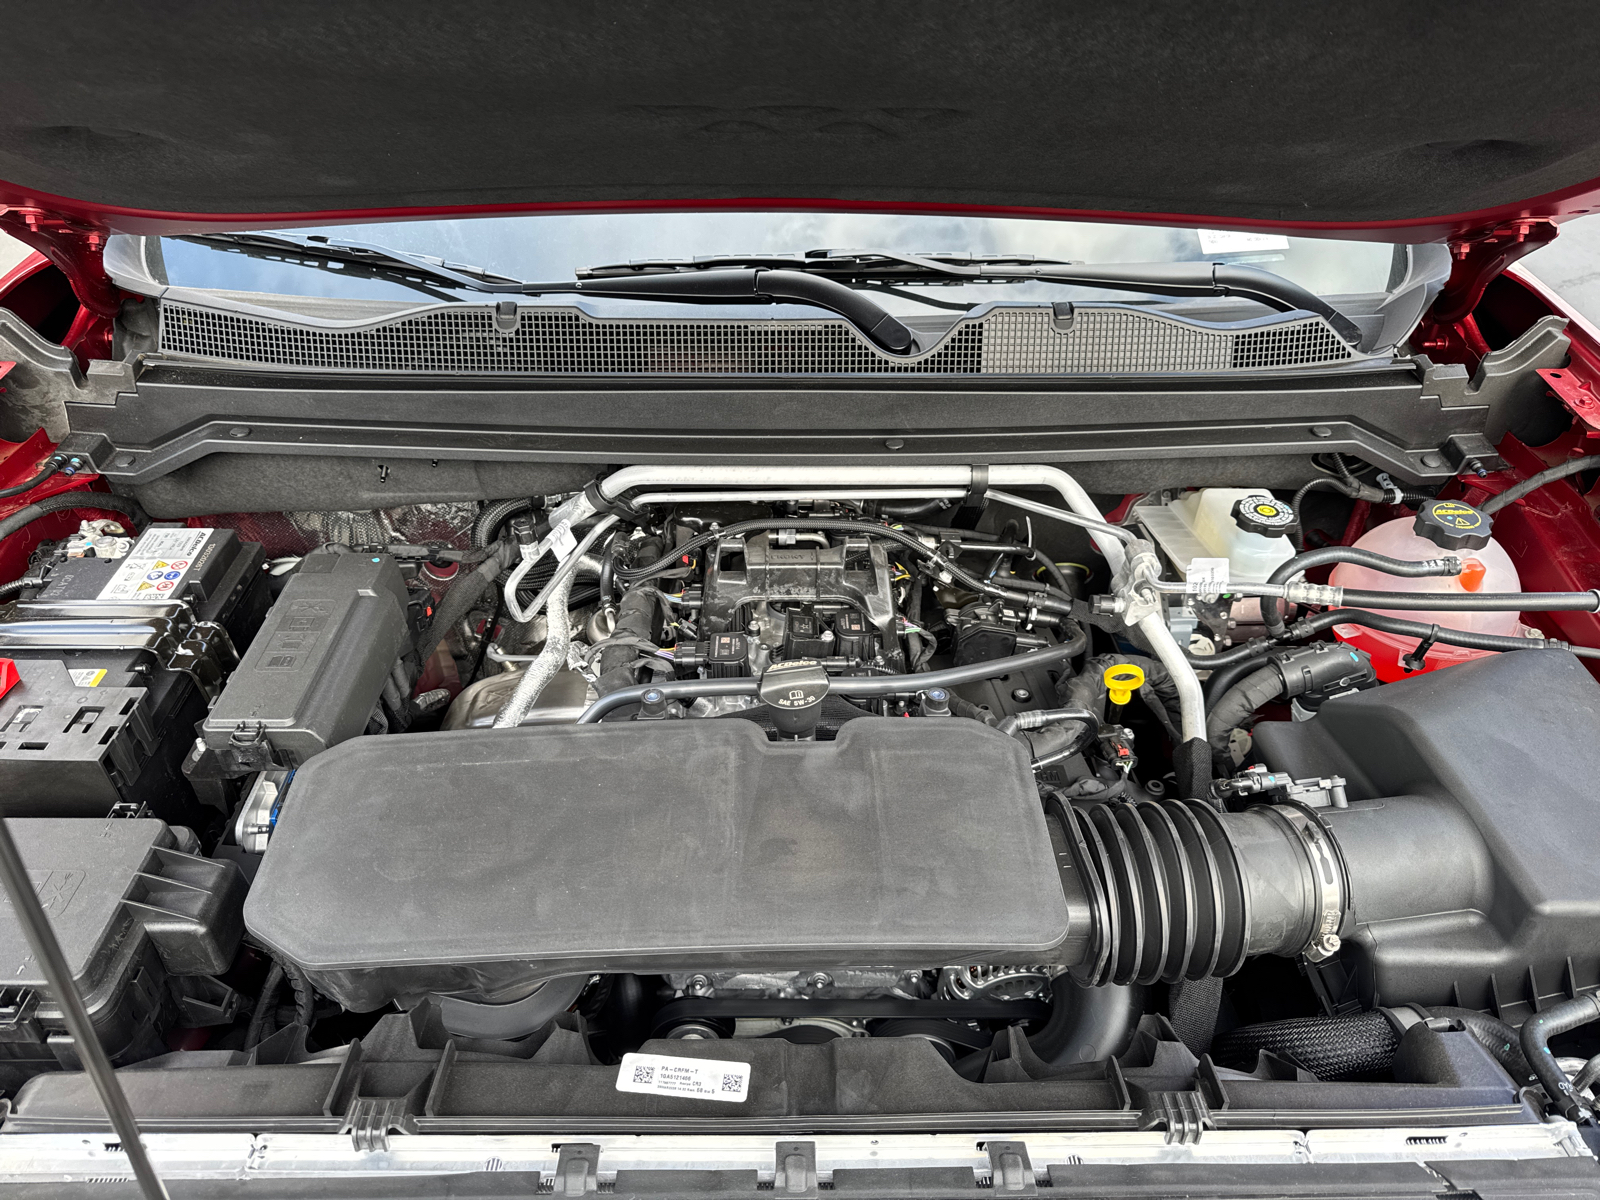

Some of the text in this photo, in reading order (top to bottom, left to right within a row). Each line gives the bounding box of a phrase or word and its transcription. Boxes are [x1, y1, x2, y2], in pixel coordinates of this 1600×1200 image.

[186, 532, 206, 557] ACDelco
[766, 660, 818, 673] ACDelco
[778, 695, 816, 706] SAE 5W-30
